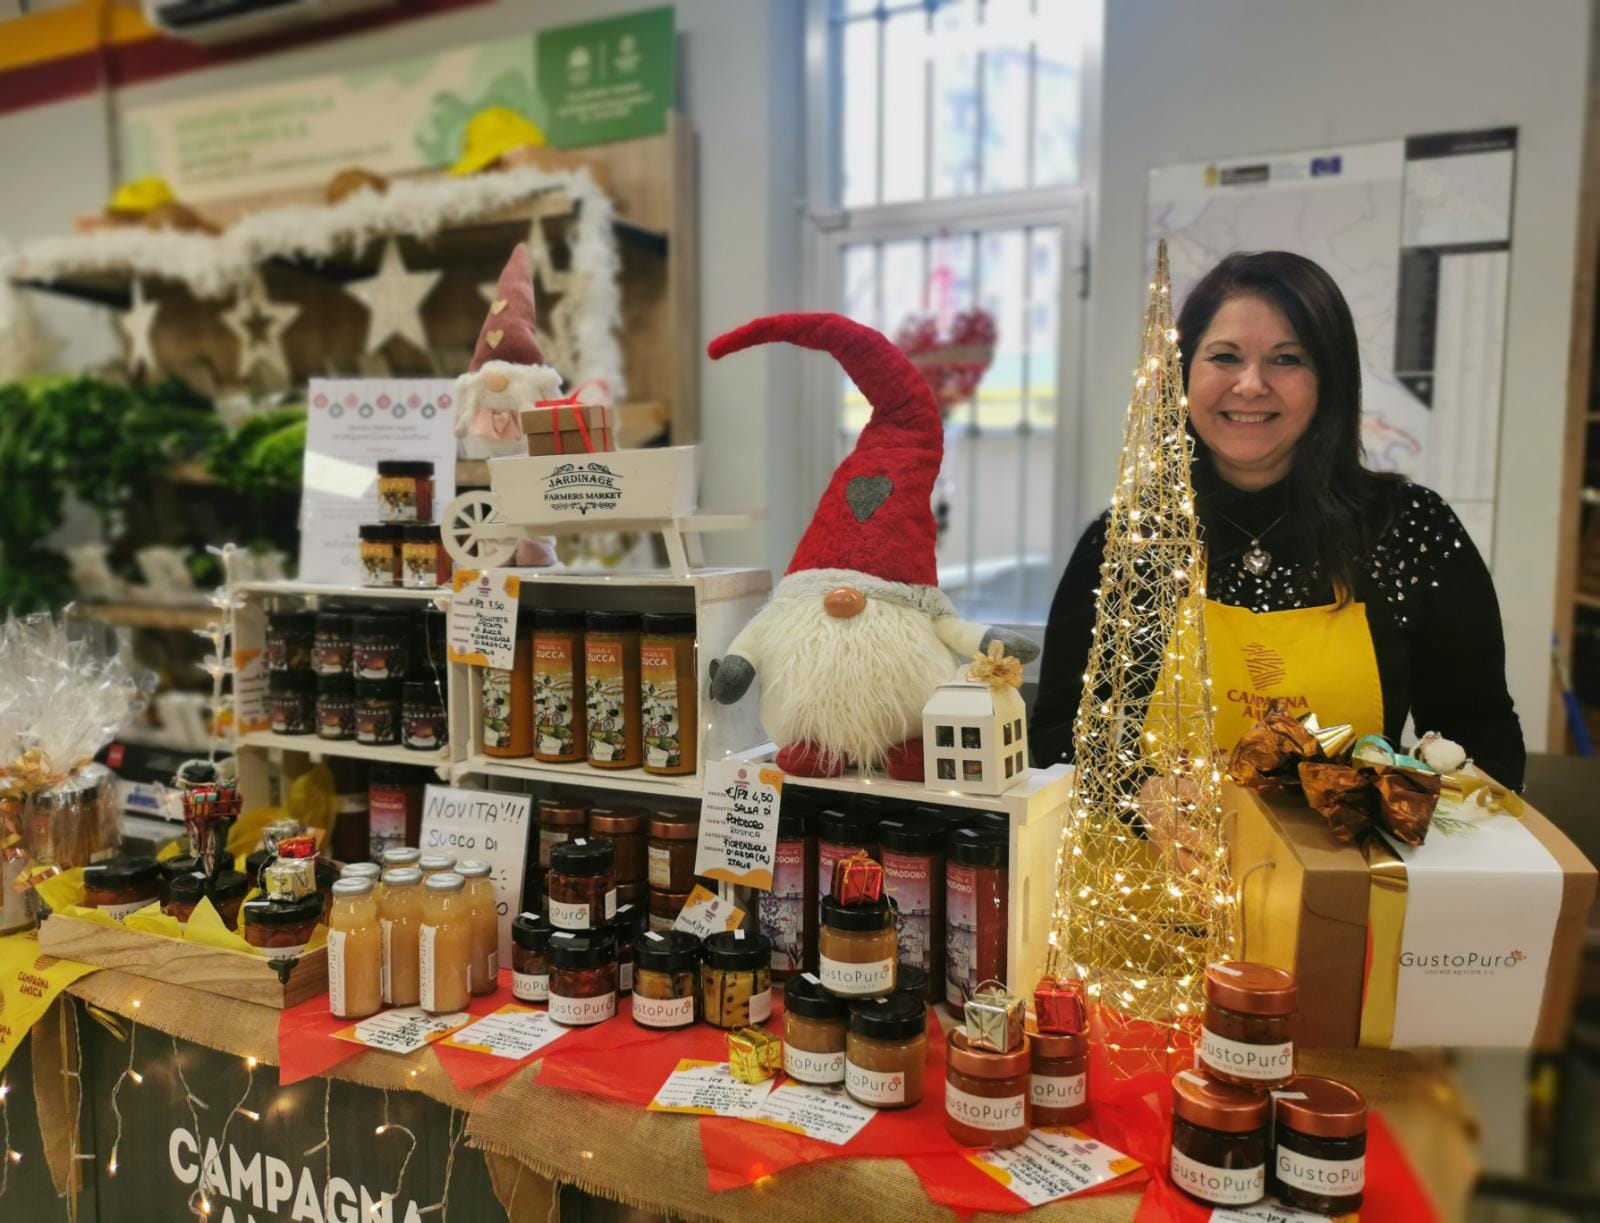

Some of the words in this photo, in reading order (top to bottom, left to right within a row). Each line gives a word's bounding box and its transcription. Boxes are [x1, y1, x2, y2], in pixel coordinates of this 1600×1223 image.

[549, 474, 614, 488] JARDINAGE
[544, 493, 584, 501] FARMERS
[586, 492, 623, 500] MARKET
[536, 650, 565, 659] ZUCCA
[587, 653, 615, 663] ZUCCA
[641, 657, 668, 667] ZUCCA
[752, 792, 774, 804] 4,50
[734, 803, 759, 815] SALSA
[726, 813, 764, 829] POMODORO
[730, 826, 760, 838] RUSTICA
[429, 829, 476, 849] SUCCO
[485, 837, 498, 851] DI
[723, 838, 767, 852] FIORENZUOLA
[727, 858, 751, 869] ITALIA
[775, 855, 800, 864] ODORO
[885, 867, 926, 879] POMODORO
[949, 880, 972, 893] ODORO
[551, 907, 584, 921] oPuro
[1399, 952, 1518, 968] GustoPuro
[18, 971, 49, 990] CAMPAGNA
[824, 967, 888, 983] ustoPuro
[20, 985, 43, 998] AMICA
[515, 981, 548, 990] stoPu
[552, 1001, 614, 1016] ustoPuro
[634, 1003, 690, 1017] ustoPuro
[787, 1053, 840, 1072] stoPuro
[849, 1073, 899, 1092] toPuro
[1034, 1084, 1082, 1097] oPuro
[949, 1100, 1021, 1120] ustoPuro
[1173, 1155, 1261, 1191] GustoPuro
[1280, 1156, 1363, 1184] GustoPur
